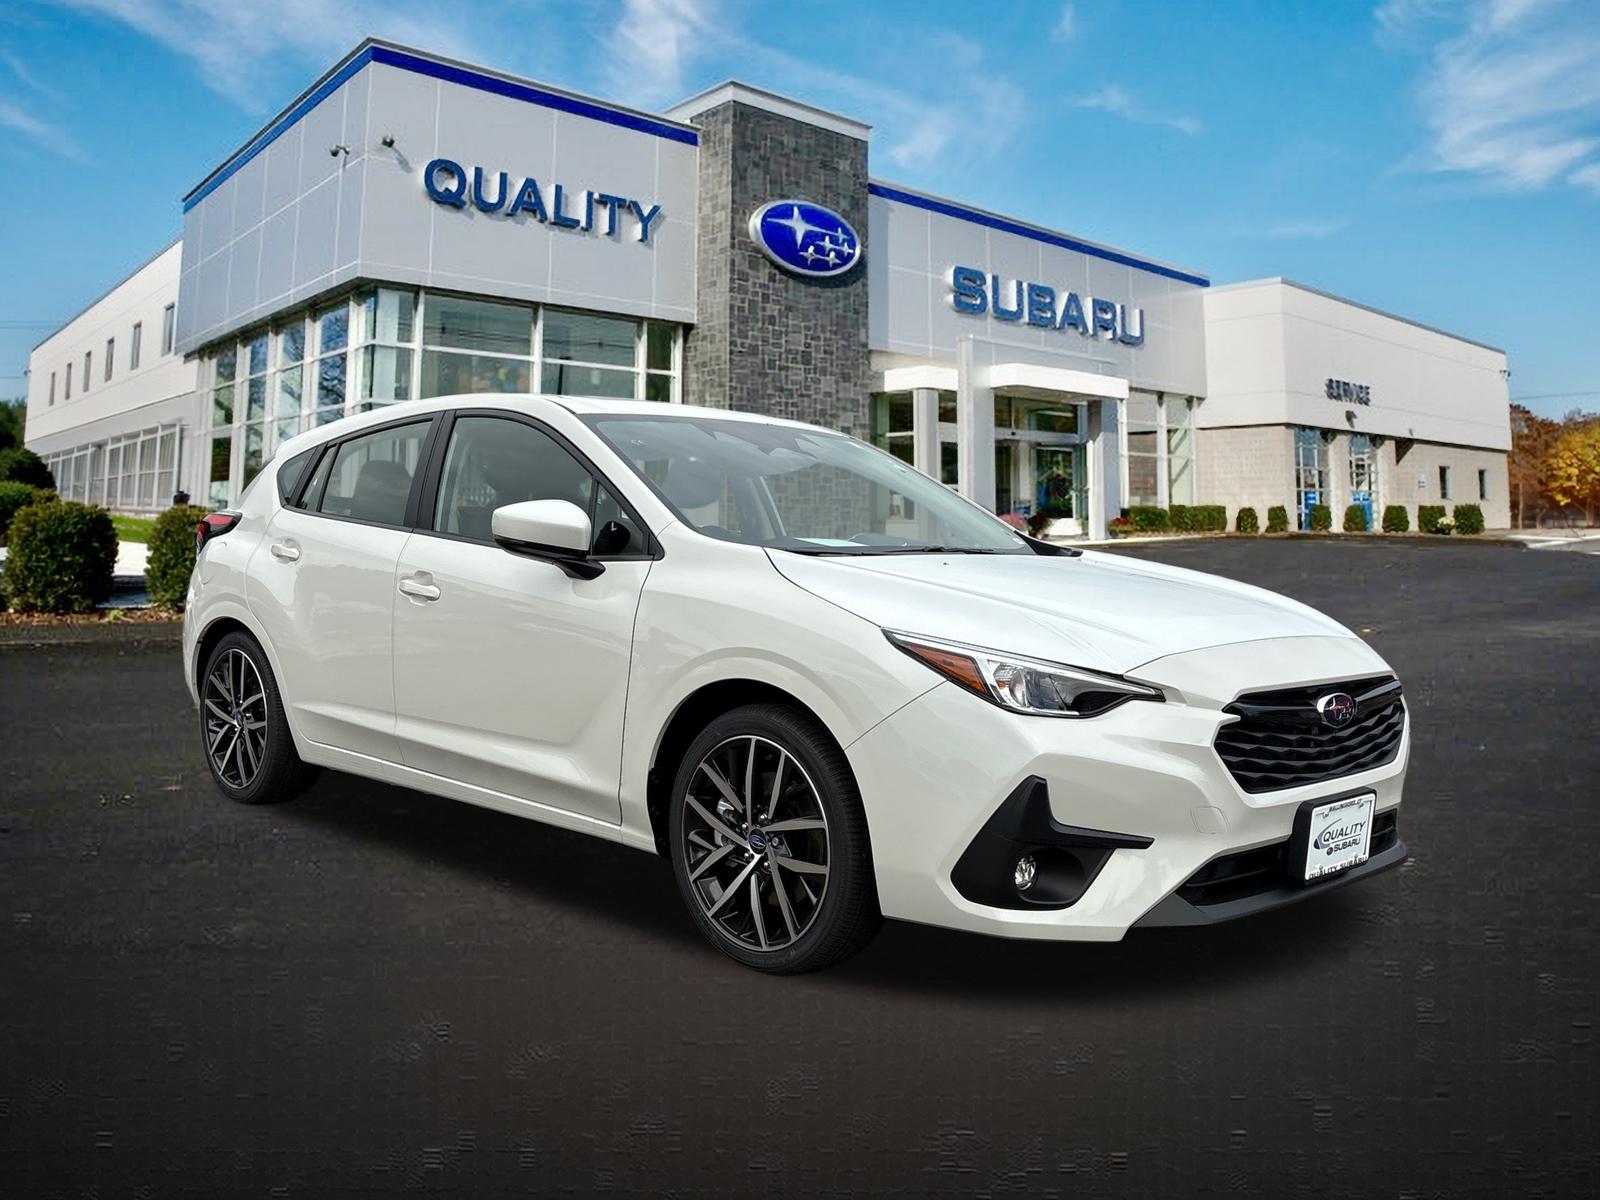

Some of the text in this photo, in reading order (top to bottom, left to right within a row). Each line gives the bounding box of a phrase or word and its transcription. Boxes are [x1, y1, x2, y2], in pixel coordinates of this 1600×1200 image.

[424, 158, 661, 242] QUALITY
[952, 265, 1145, 346] SUBARU
[1323, 820, 1367, 842] QUALITY
[1333, 837, 1361, 853] SUBARU
